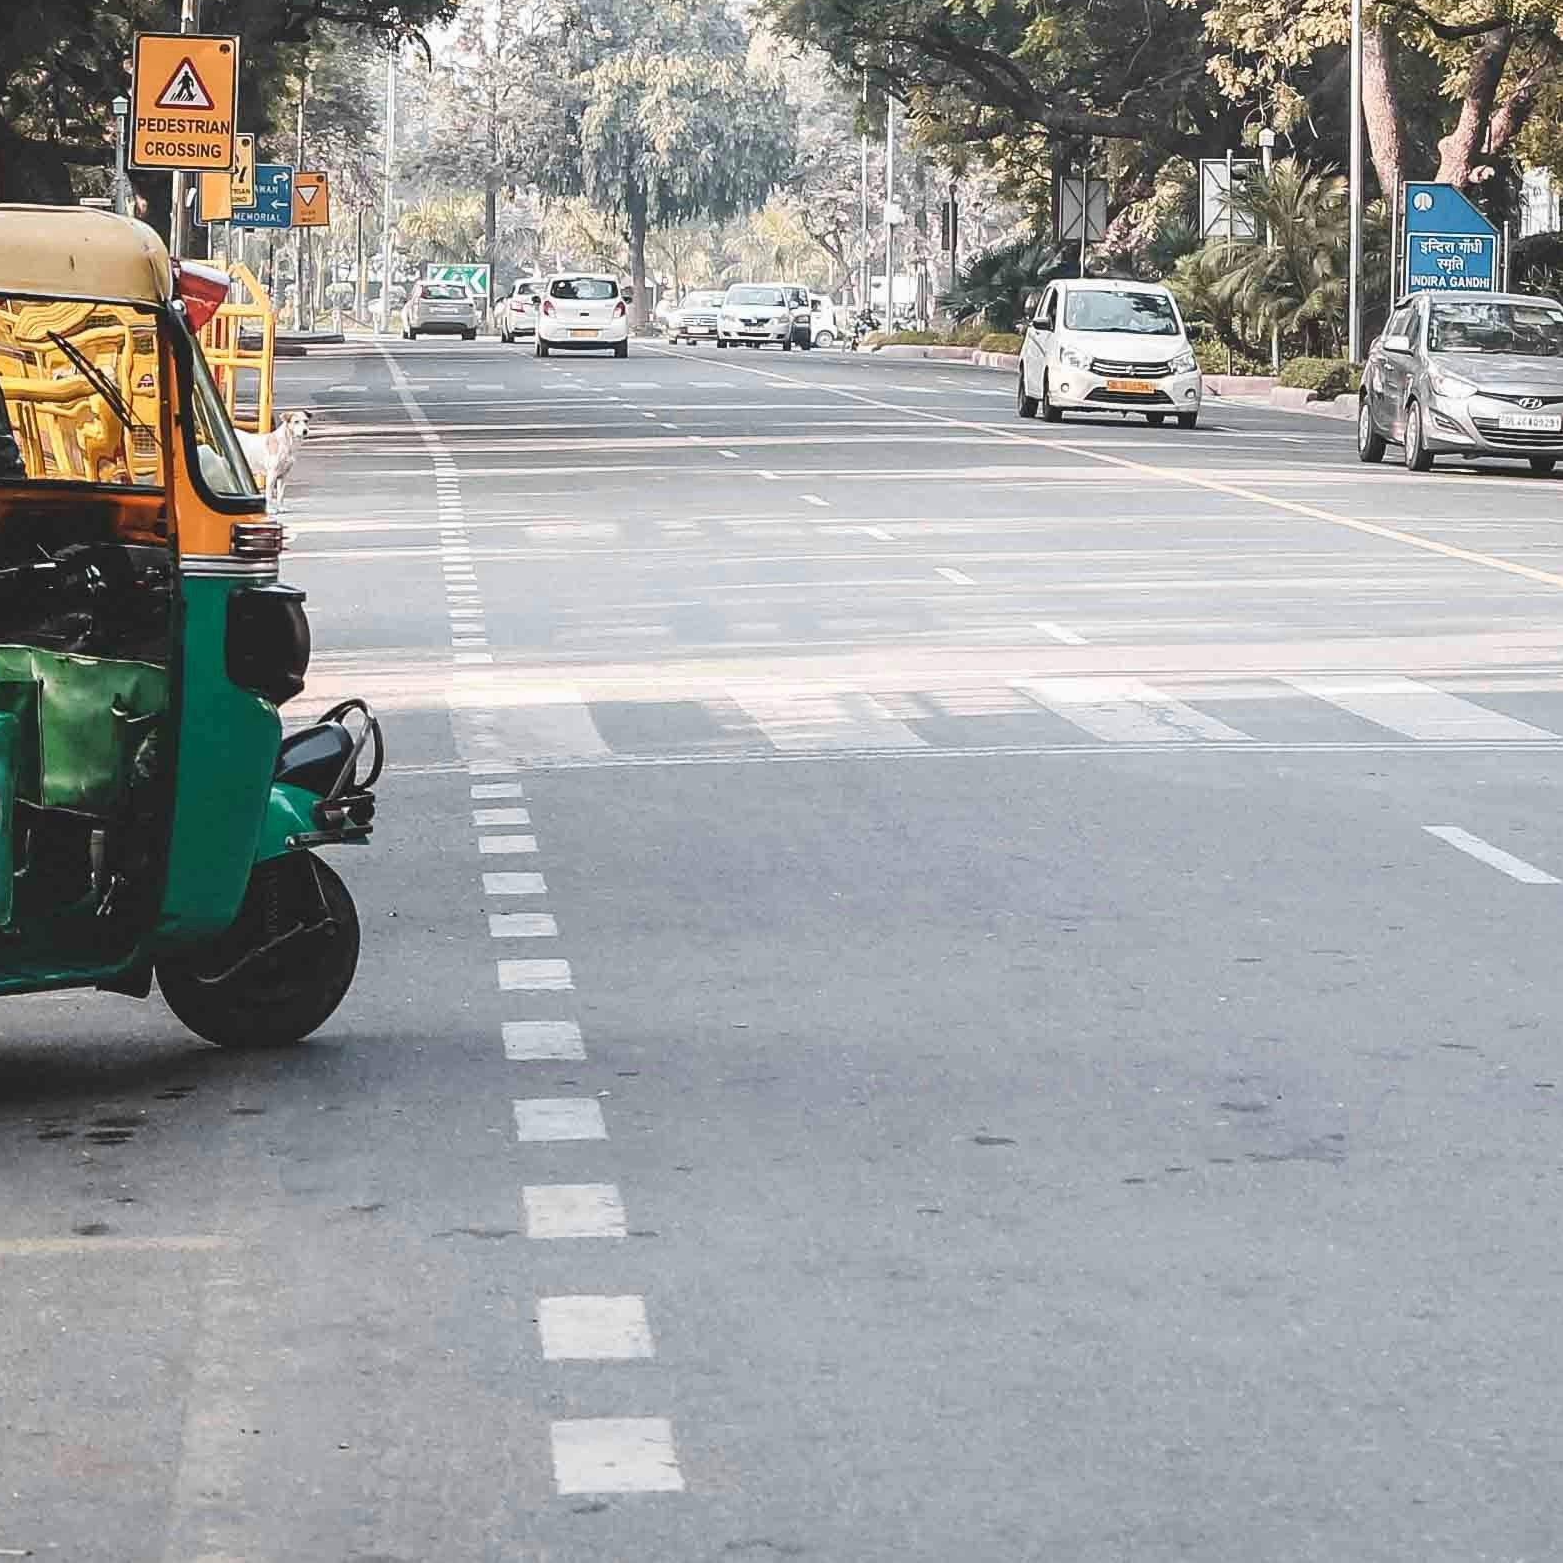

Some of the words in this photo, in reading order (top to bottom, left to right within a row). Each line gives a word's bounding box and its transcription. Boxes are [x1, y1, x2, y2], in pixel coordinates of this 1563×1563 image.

[137, 117, 230, 135] PEDESTRIAN
[144, 141, 222, 158] CROSSING
[233, 212, 281, 223] MEMORIAL
[1411, 275, 1446, 287] INDIRA
[1449, 277, 1490, 289] GANDHI
